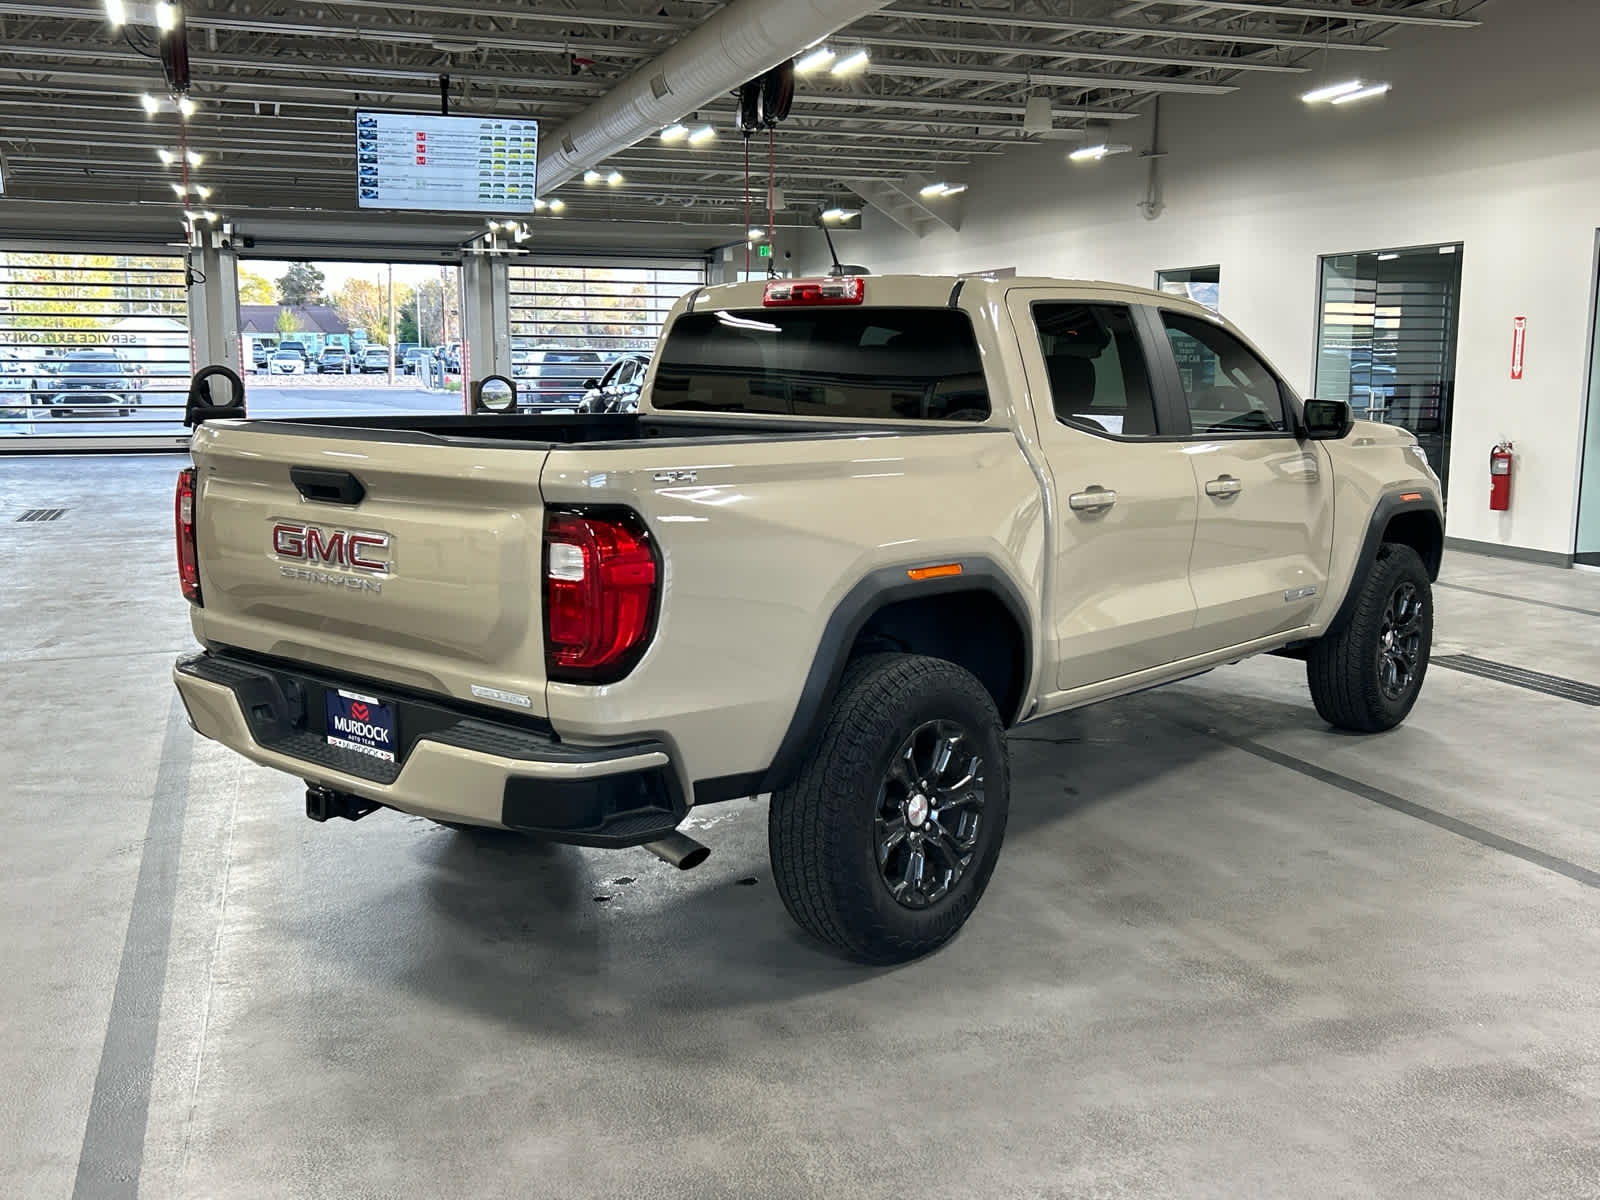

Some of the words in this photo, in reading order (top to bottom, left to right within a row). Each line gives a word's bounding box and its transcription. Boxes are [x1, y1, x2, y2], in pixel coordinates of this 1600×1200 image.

[272, 522, 390, 575] GMC
[334, 715, 389, 743] MURDOCK
[347, 735, 361, 743] AUTO
